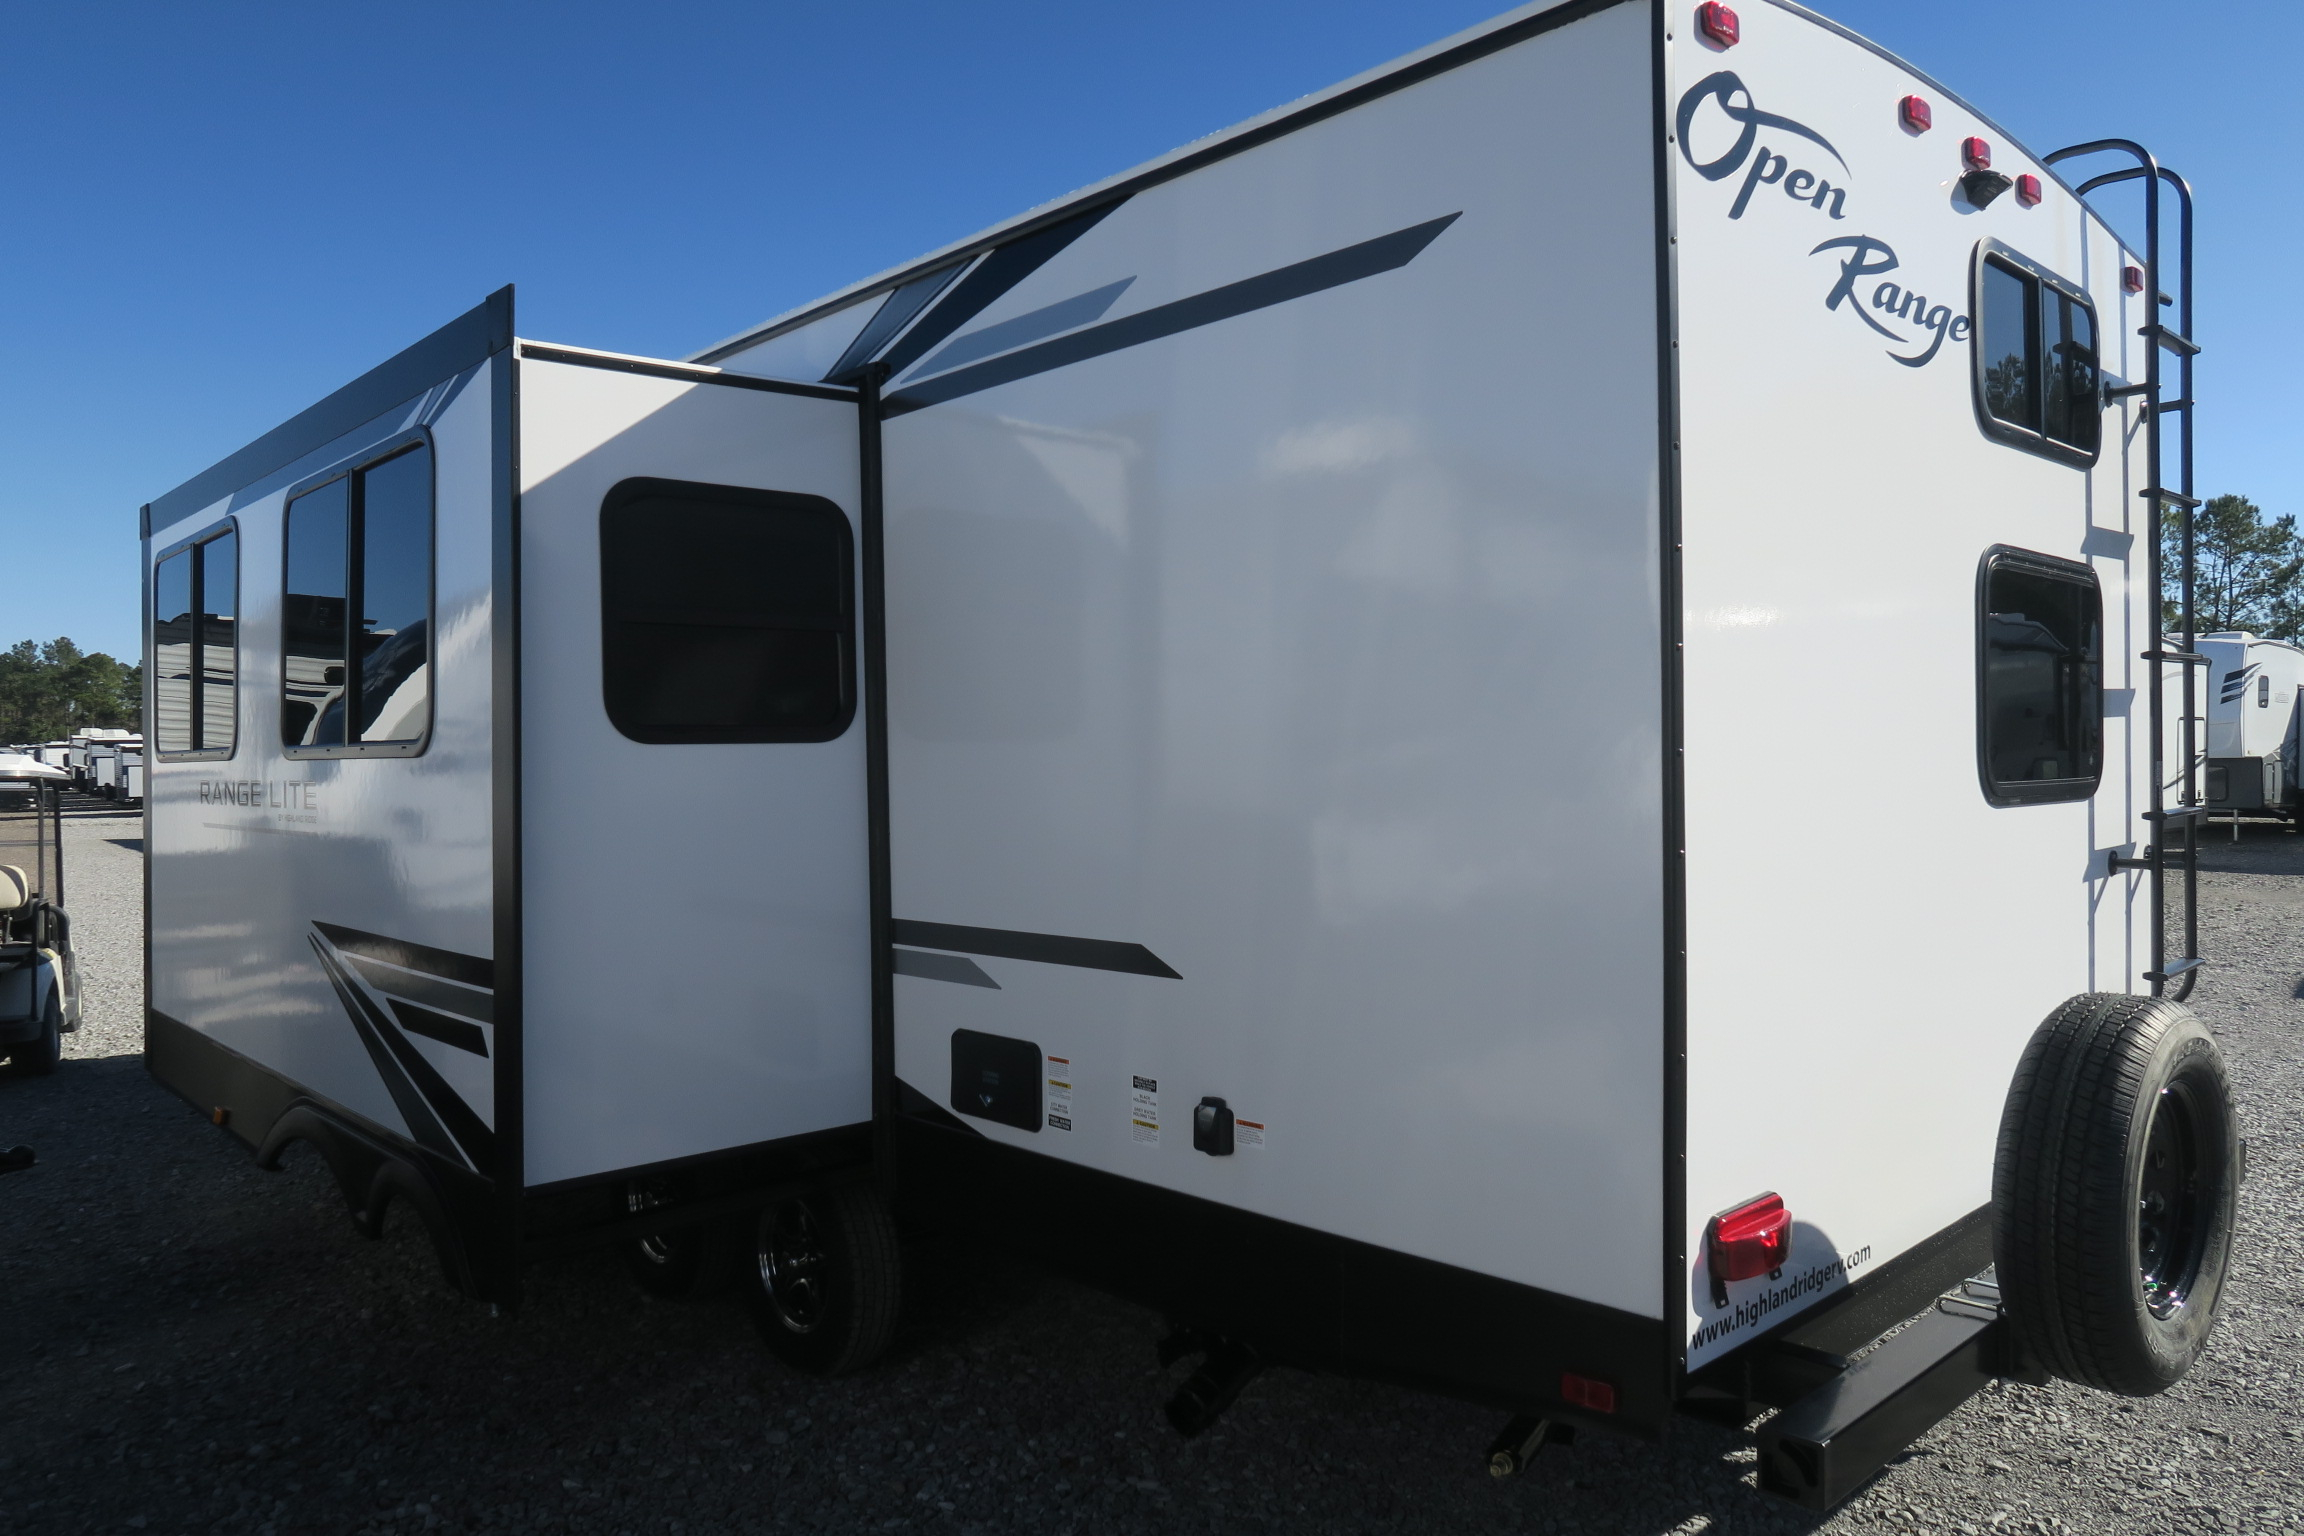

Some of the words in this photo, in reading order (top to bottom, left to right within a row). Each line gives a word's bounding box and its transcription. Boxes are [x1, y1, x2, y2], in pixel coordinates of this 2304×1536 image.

[1676, 70, 1852, 220] Open
[1808, 234, 1970, 368] Range
[200, 780, 262, 807] RANGE
[269, 780, 318, 810] LITE
[1692, 1244, 1871, 1350] www.highlandridgerv.com
